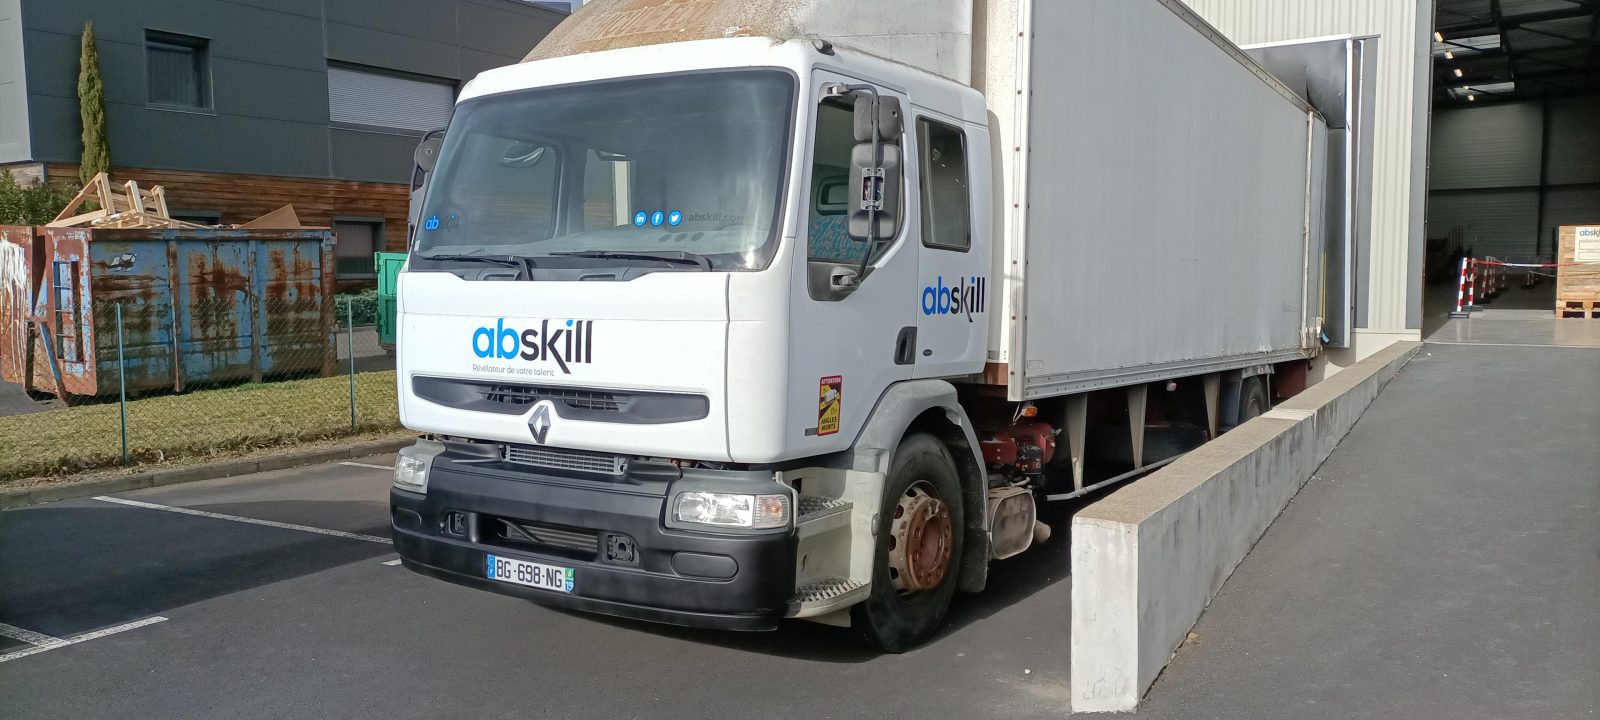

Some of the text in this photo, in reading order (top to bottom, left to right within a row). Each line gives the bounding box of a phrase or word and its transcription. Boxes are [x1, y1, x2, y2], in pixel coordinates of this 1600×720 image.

[922, 276, 985, 323] abskill
[472, 318, 593, 375] abskill
[472, 363, 554, 377] Révélateur de votre talent
